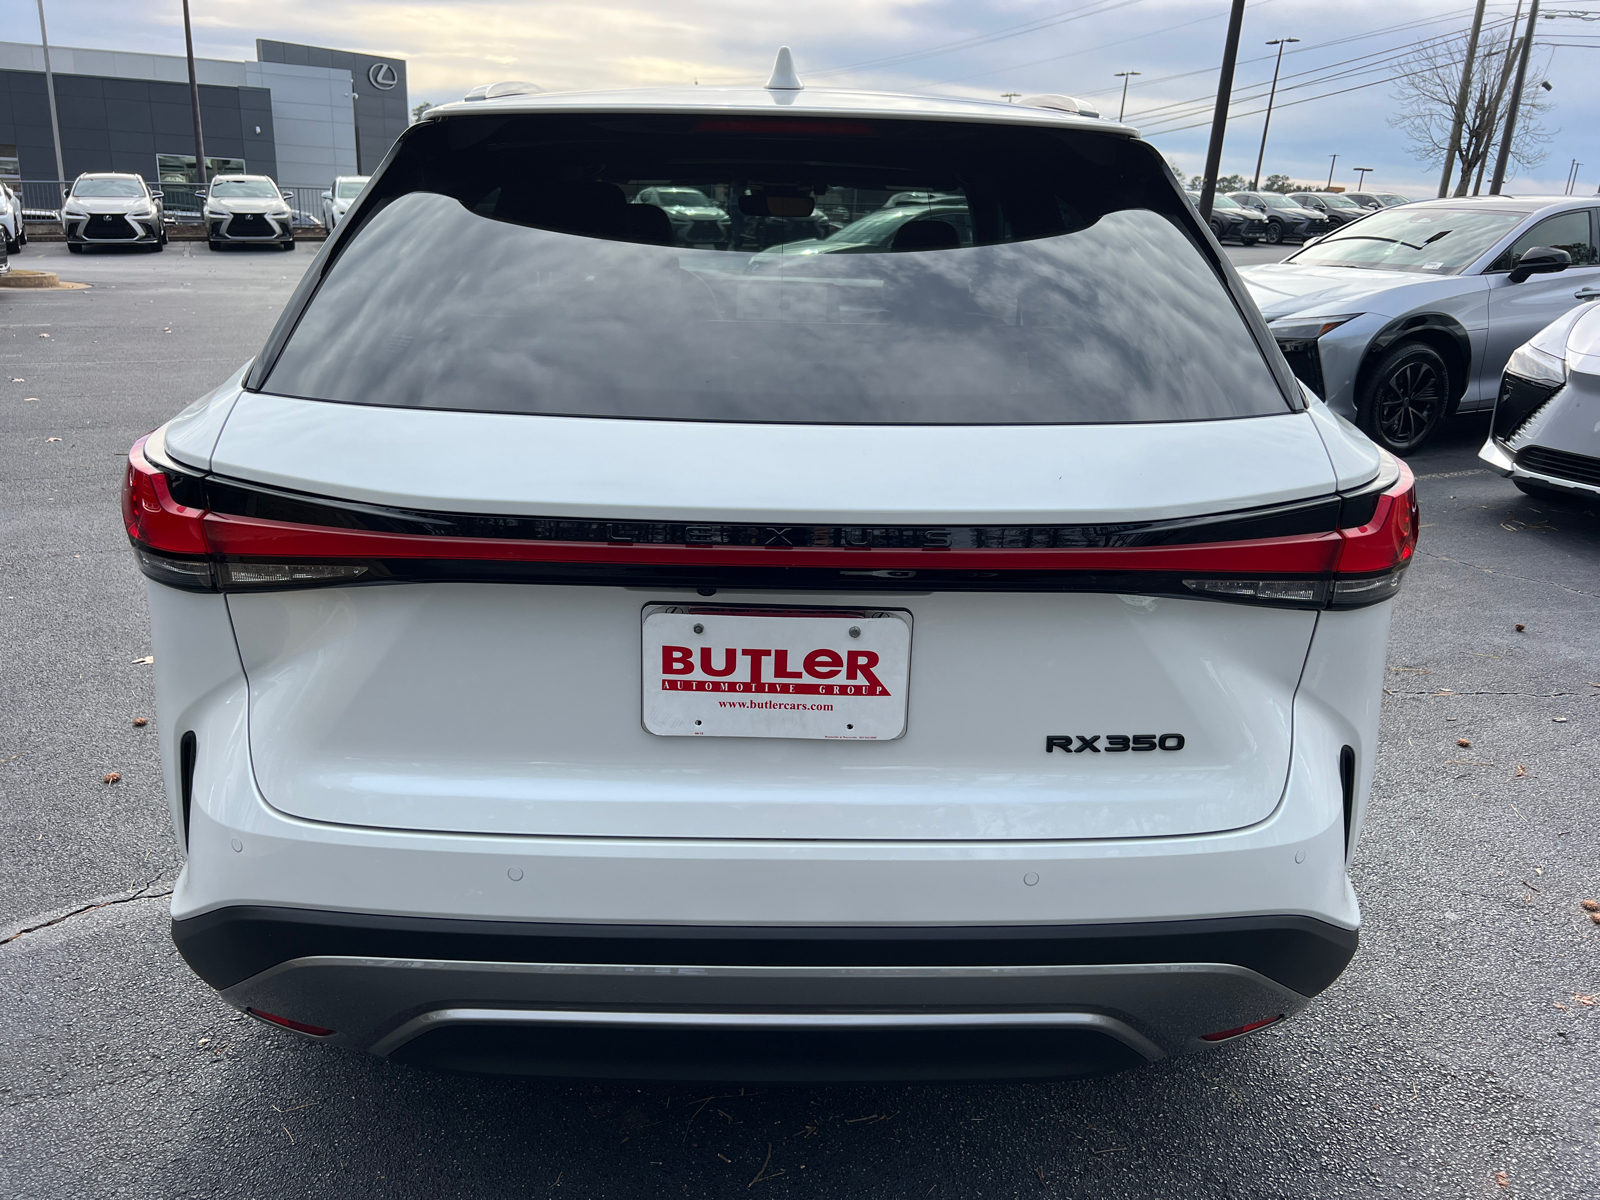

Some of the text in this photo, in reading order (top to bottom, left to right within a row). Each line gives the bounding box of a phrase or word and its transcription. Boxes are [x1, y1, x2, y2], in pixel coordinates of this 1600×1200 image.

[605, 523, 953, 548] LEXUS
[663, 680, 883, 696] AUTOMOTIVE GROUP
[718, 699, 835, 712] www.butlercars.com
